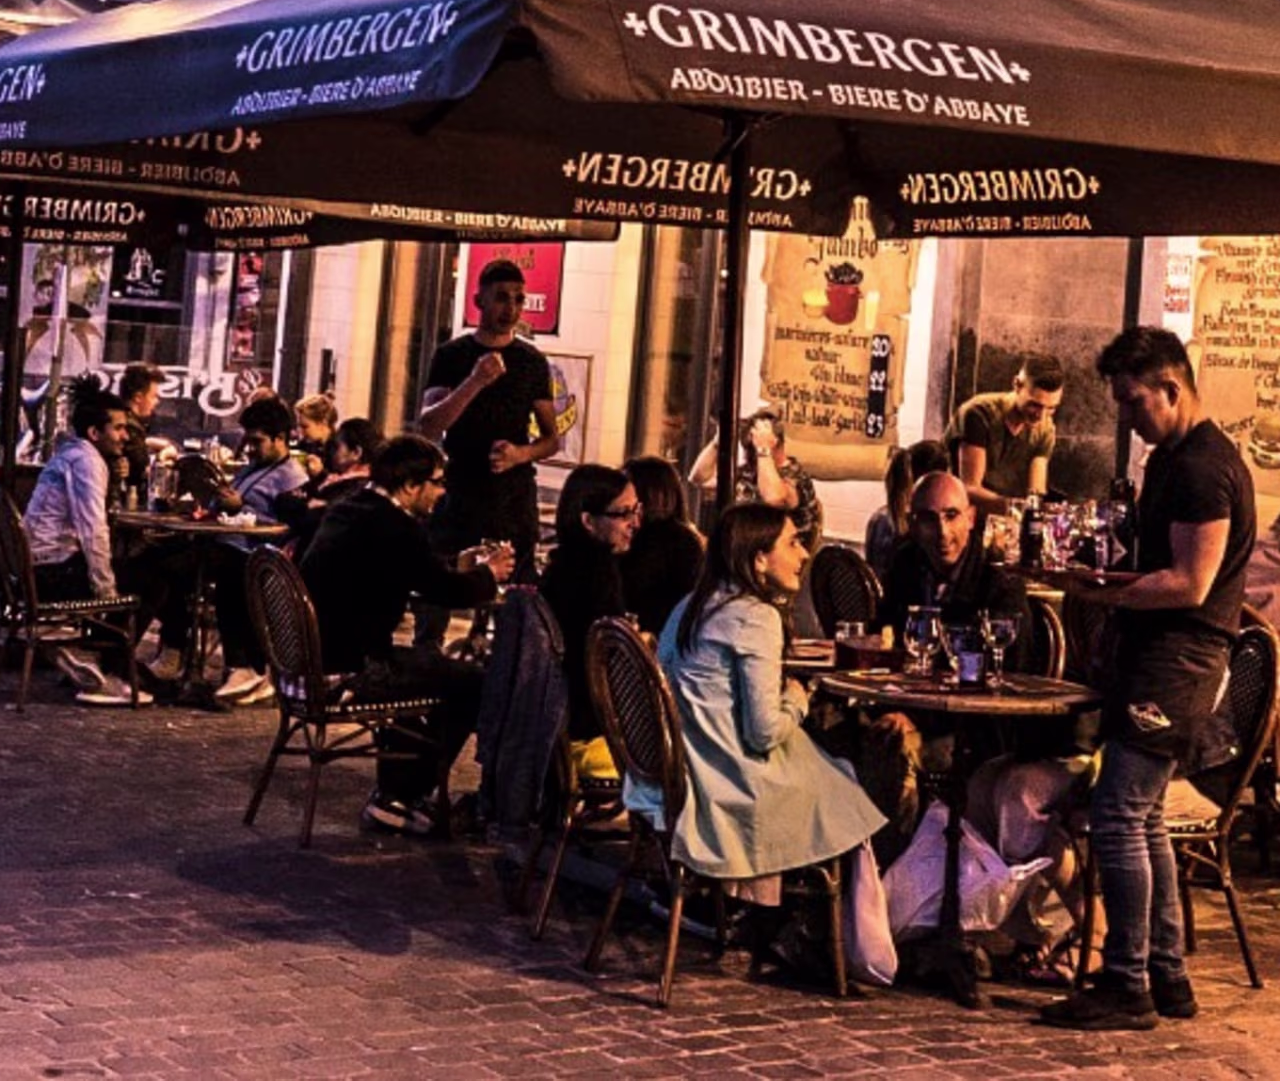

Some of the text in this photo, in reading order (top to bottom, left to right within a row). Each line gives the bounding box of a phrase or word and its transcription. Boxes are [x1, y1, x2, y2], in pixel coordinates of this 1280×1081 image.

[247, 1, 455, 73] GRIMBERGEN
[648, 3, 1014, 84] GRIMBERGEN
[828, 83, 902, 112] BIERE
[903, 88, 1030, 126] D'ABBAYE
